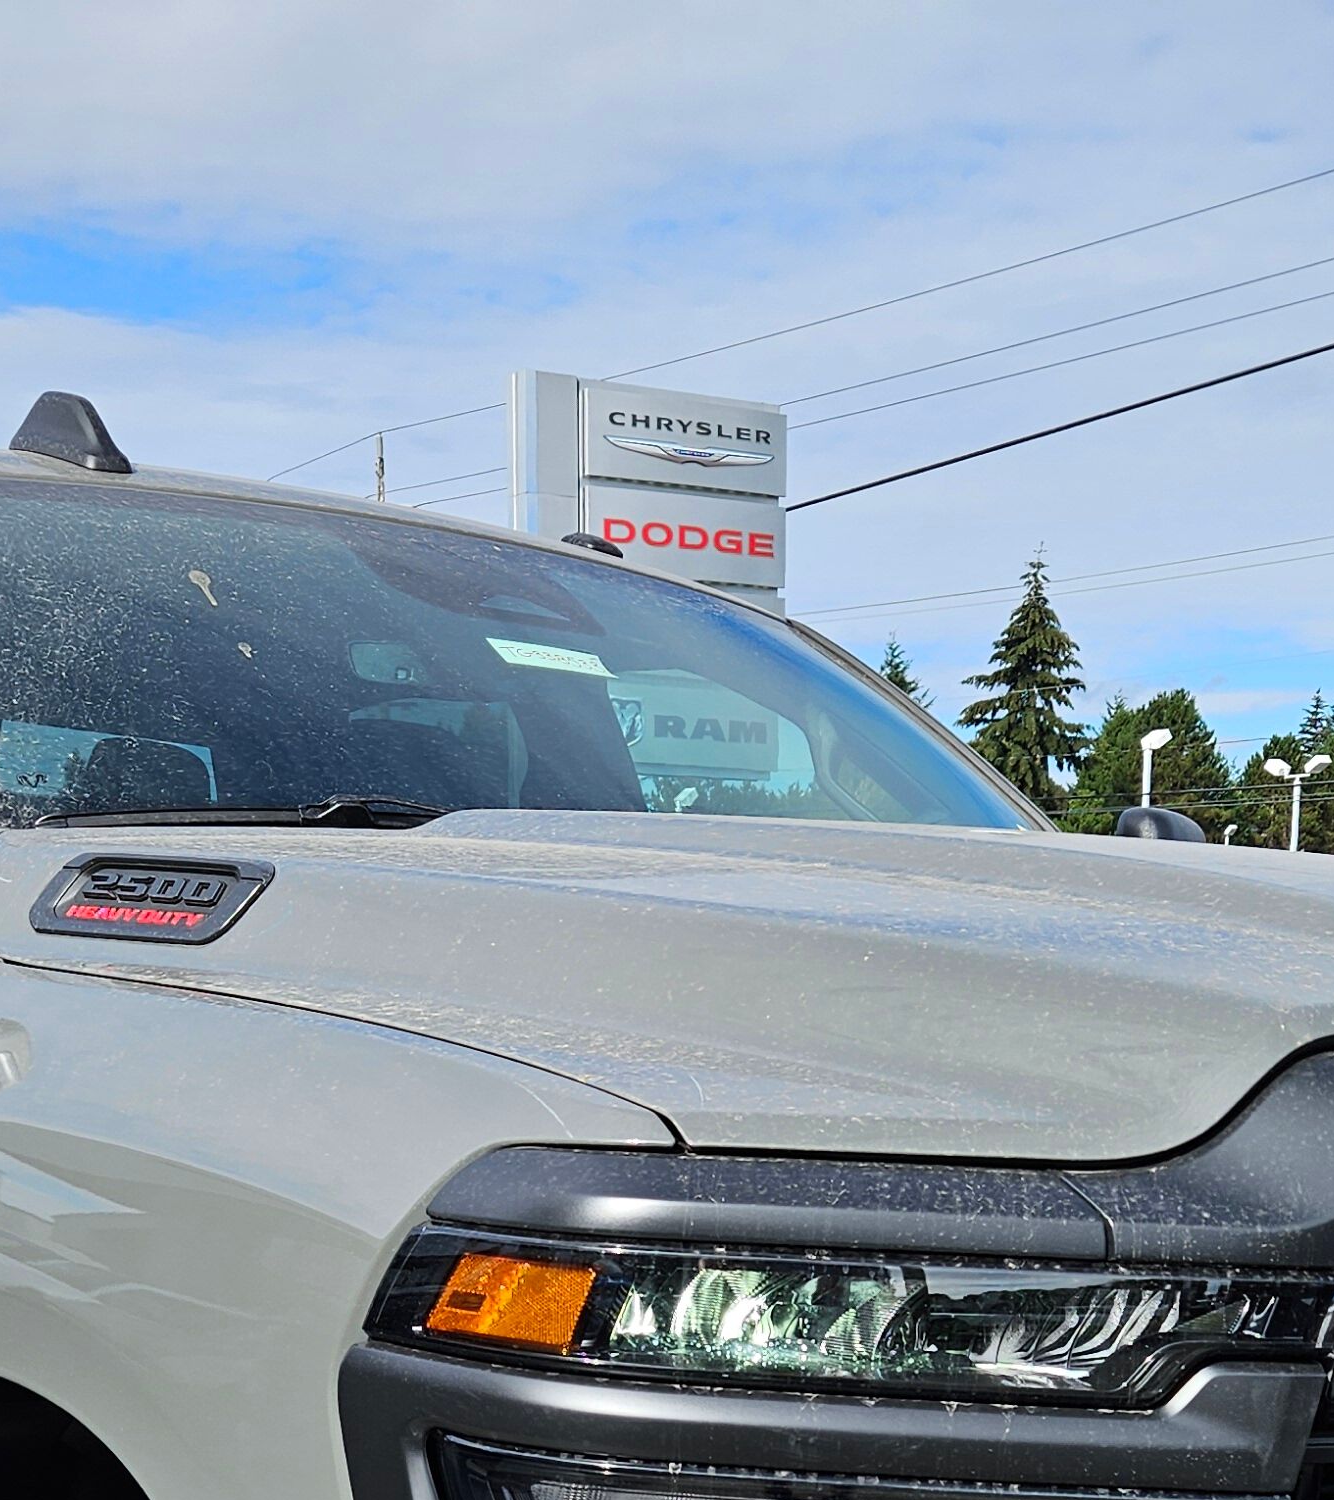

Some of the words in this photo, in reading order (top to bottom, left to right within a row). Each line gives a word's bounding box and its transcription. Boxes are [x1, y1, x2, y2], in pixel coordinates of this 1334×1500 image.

[608, 411, 772, 445] CHRYSLER
[603, 518, 775, 559] DODGE
[653, 714, 768, 744] RAM
[82, 872, 227, 907] 2500
